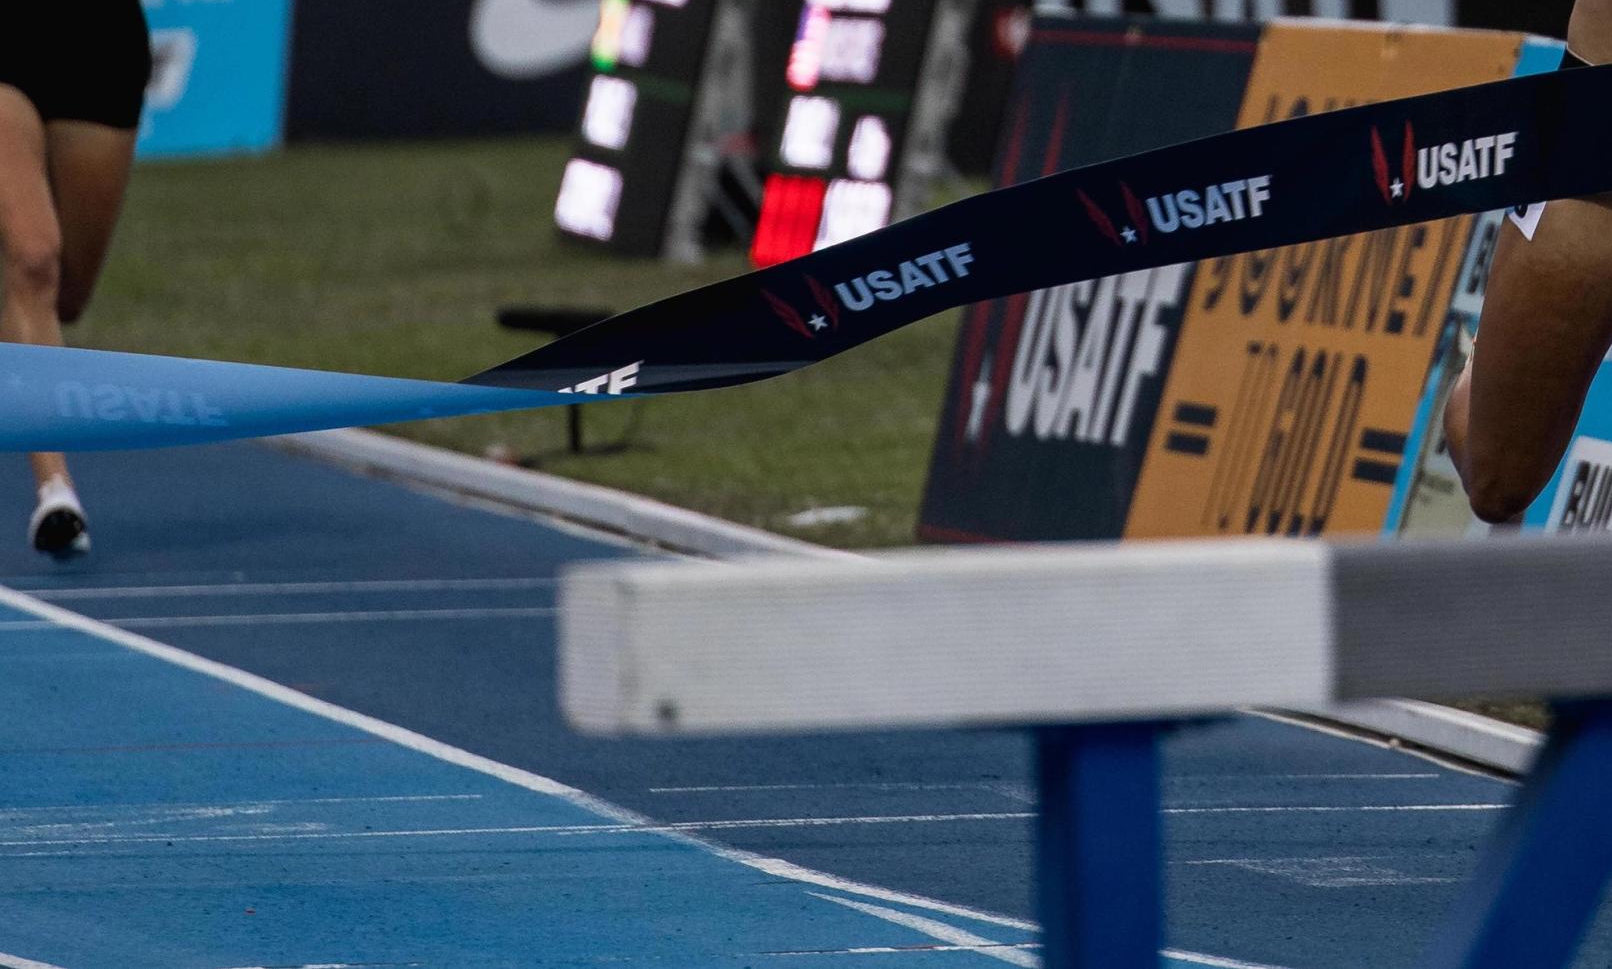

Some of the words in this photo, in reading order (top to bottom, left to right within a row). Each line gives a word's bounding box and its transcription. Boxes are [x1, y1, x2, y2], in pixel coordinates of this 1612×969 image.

[1416, 131, 1521, 190] USATF
[1147, 174, 1274, 234] USATF
[835, 242, 977, 313] USATF
[1004, 261, 1190, 447] USATF
